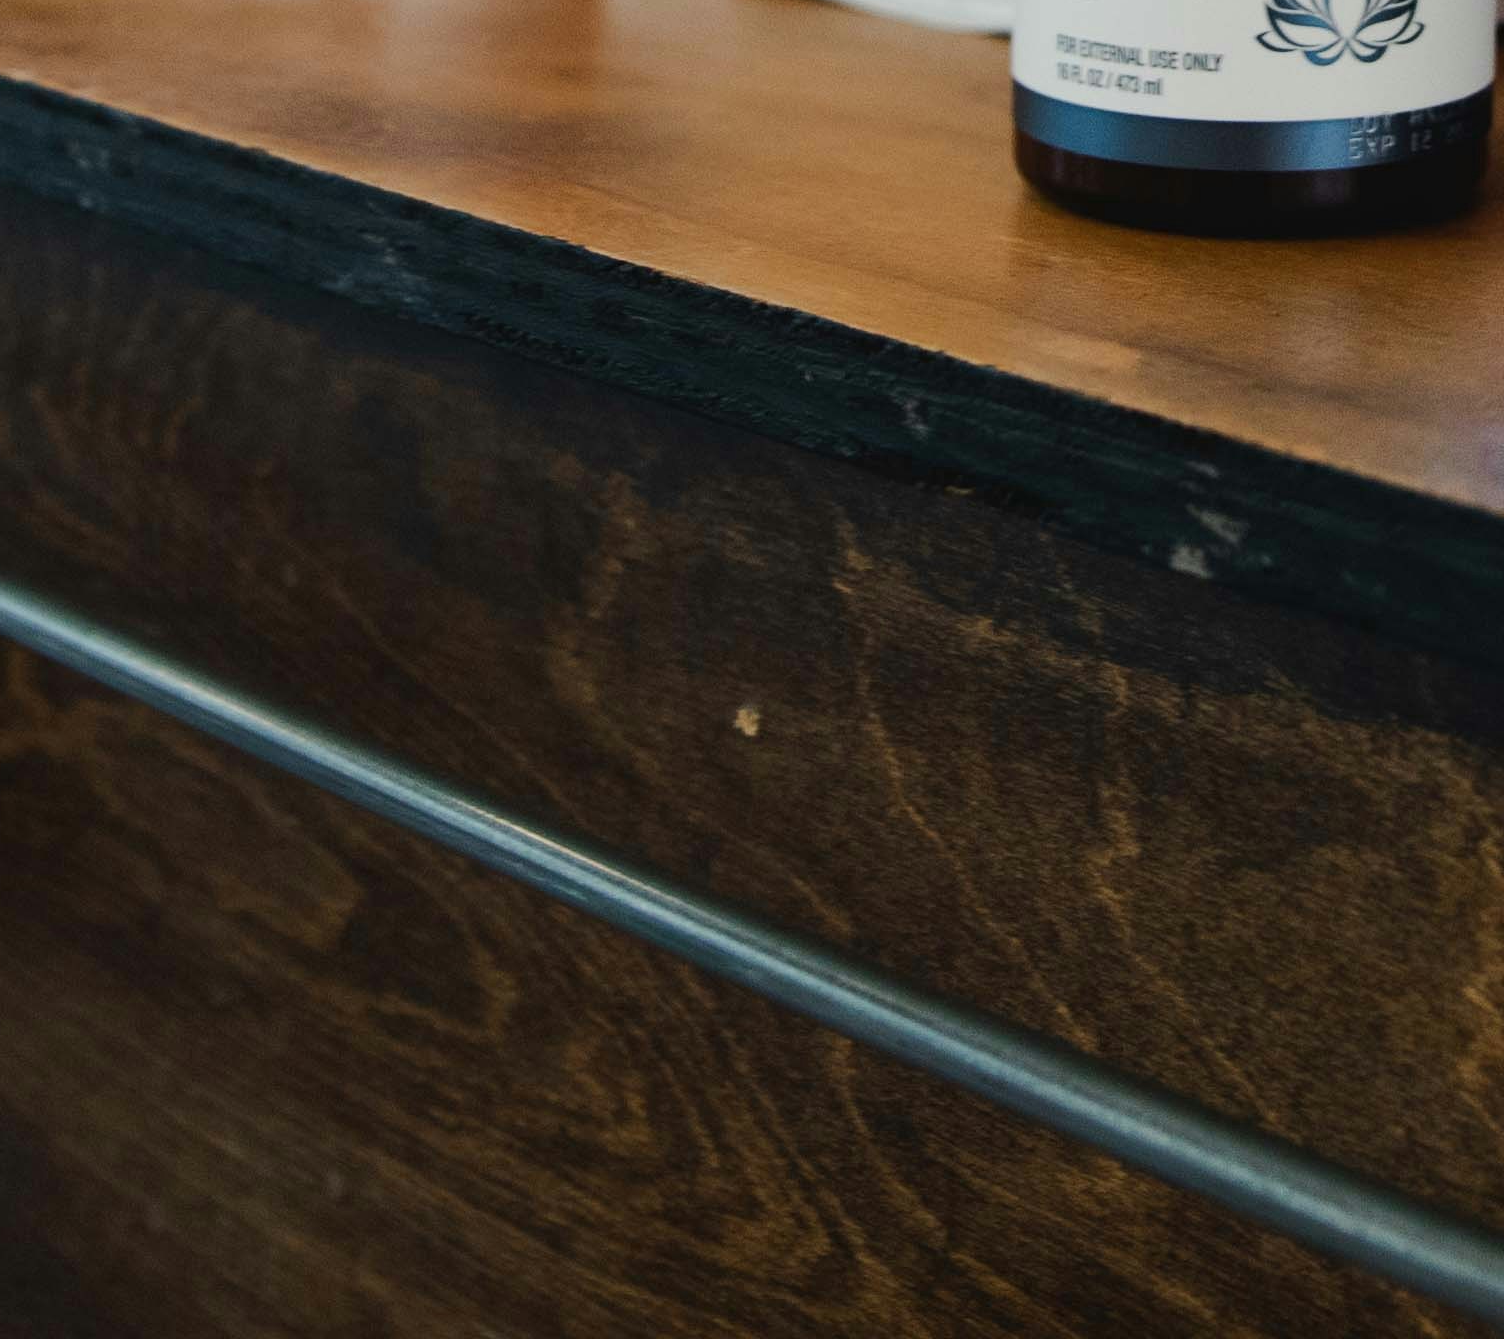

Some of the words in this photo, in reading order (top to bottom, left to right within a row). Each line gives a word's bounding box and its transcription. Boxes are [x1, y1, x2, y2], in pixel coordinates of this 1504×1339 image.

[1056, 33, 1077, 54] FOR
[1080, 39, 1145, 66] EXTERNAL
[1149, 49, 1179, 70] USE
[1183, 53, 1224, 72] ONLY
